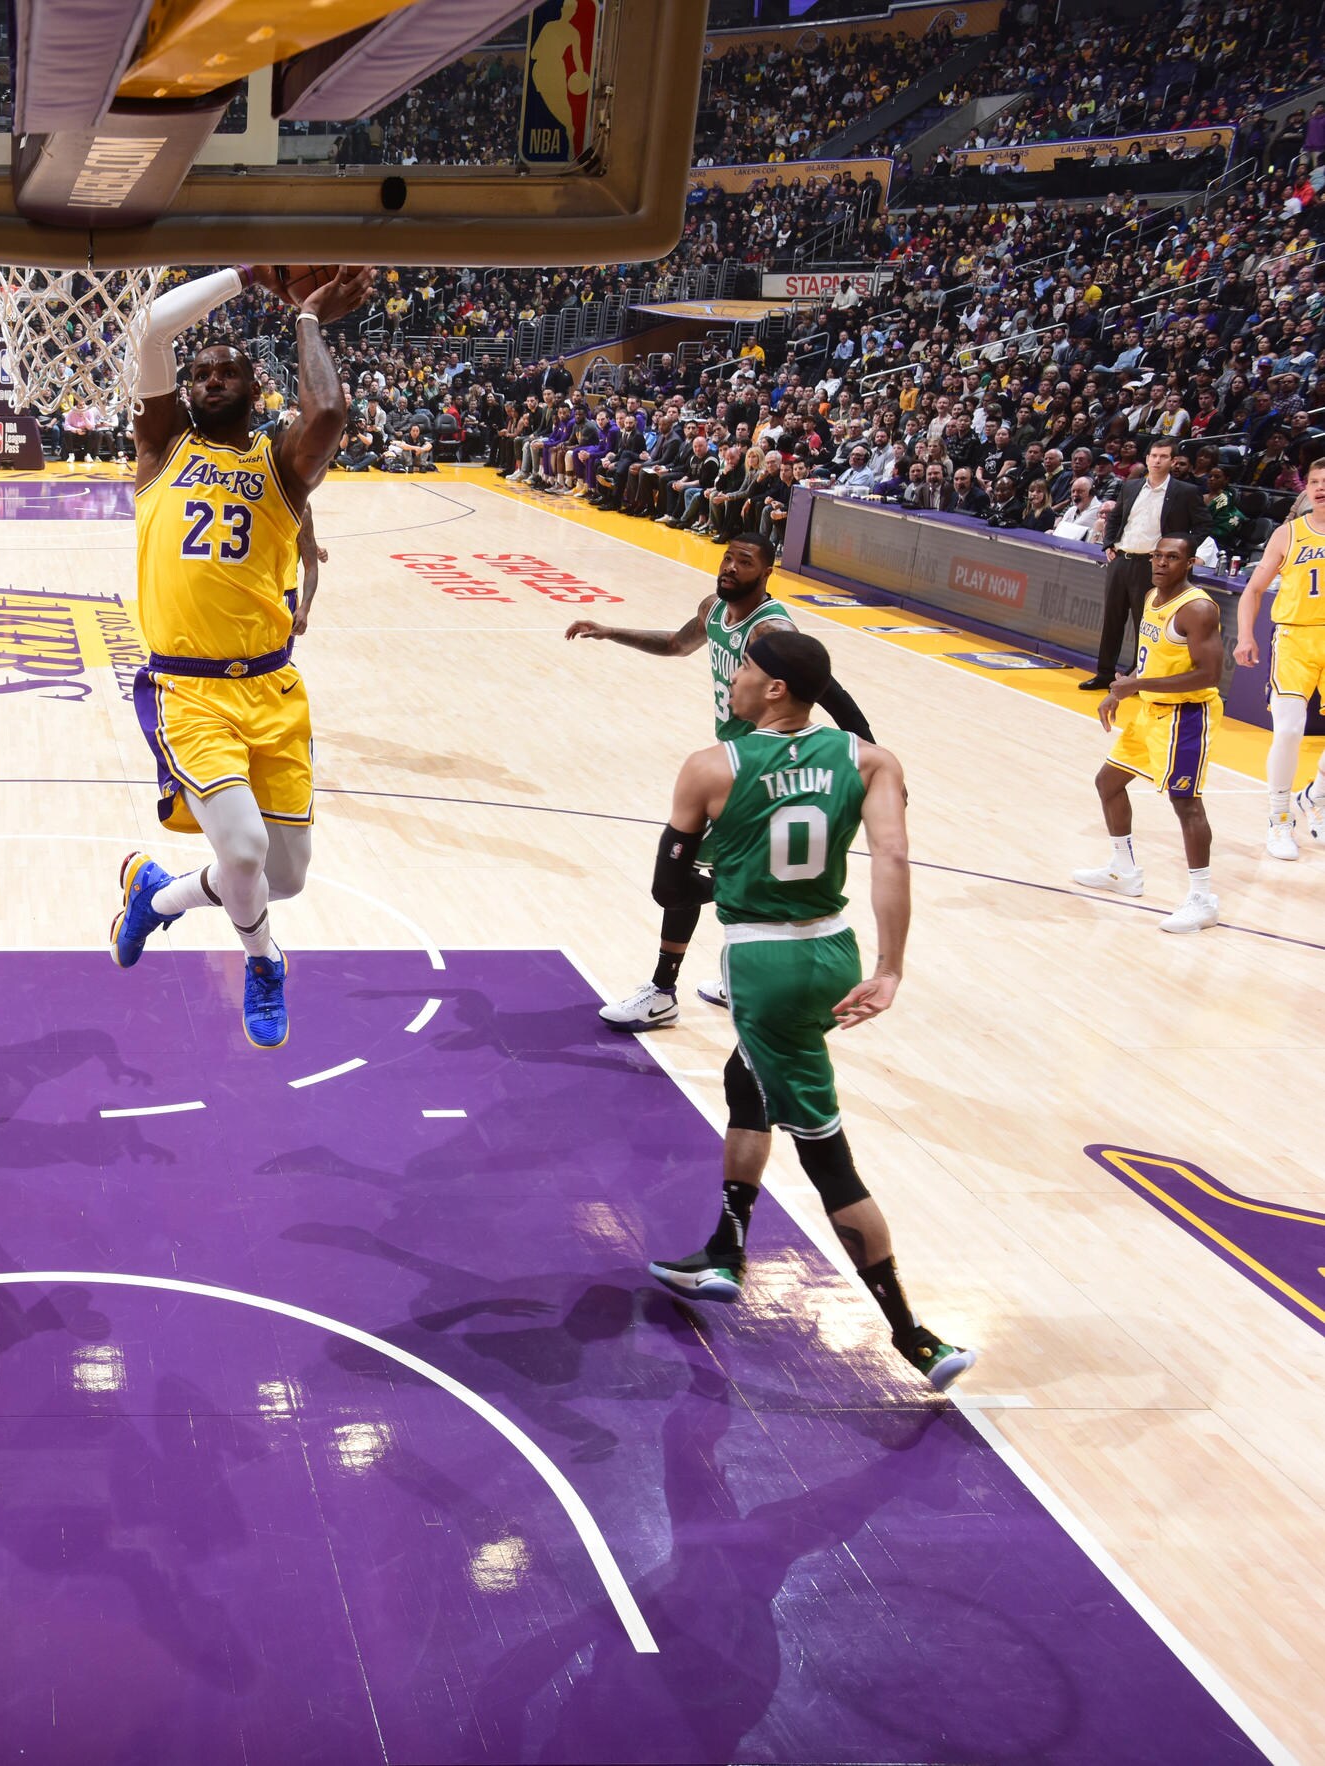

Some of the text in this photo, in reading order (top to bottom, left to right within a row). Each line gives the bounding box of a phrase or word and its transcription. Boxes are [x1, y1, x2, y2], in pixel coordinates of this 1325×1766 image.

[529, 128, 561, 154] NBA
[5, 422, 18, 433] NBA
[5, 433, 27, 445] League
[5, 444, 20, 454] Pass
[238, 455, 263, 464] wish
[169, 454, 266, 502] LAKERS
[180, 499, 253, 564] 23
[389, 553, 517, 603] Center
[472, 553, 625, 603] STAPLES
[954, 565, 1021, 600] PLAY NOW
[94, 609, 136, 632] LOS
[1137, 645, 1148, 675] 9
[759, 767, 835, 800] TATUM
[769, 805, 828, 882] 0
